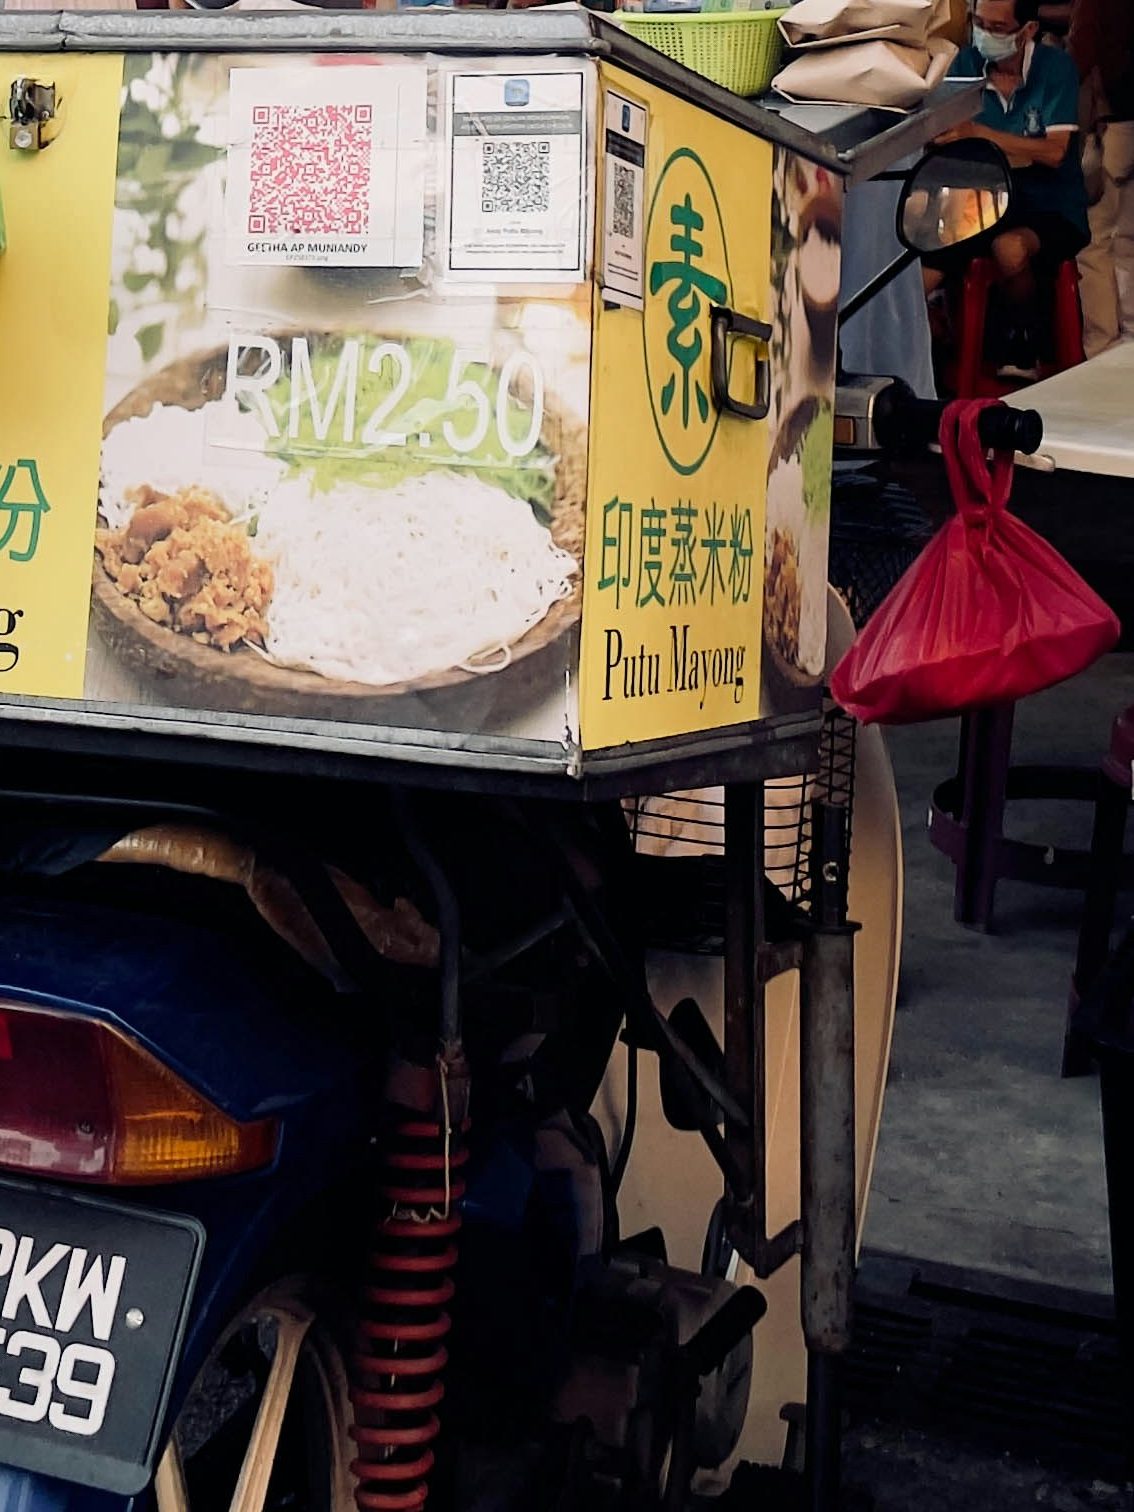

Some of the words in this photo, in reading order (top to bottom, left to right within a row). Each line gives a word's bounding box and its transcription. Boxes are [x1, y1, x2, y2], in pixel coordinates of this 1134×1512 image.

[291, 242, 304, 253] AP
[307, 242, 368, 254] MUNIANDY
[651, 192, 728, 429] 素
[225, 331, 545, 458] RM2.50
[597, 495, 754, 610] 印度蒸米粉
[601, 628, 661, 702] Putu
[667, 624, 747, 710] Mayong
